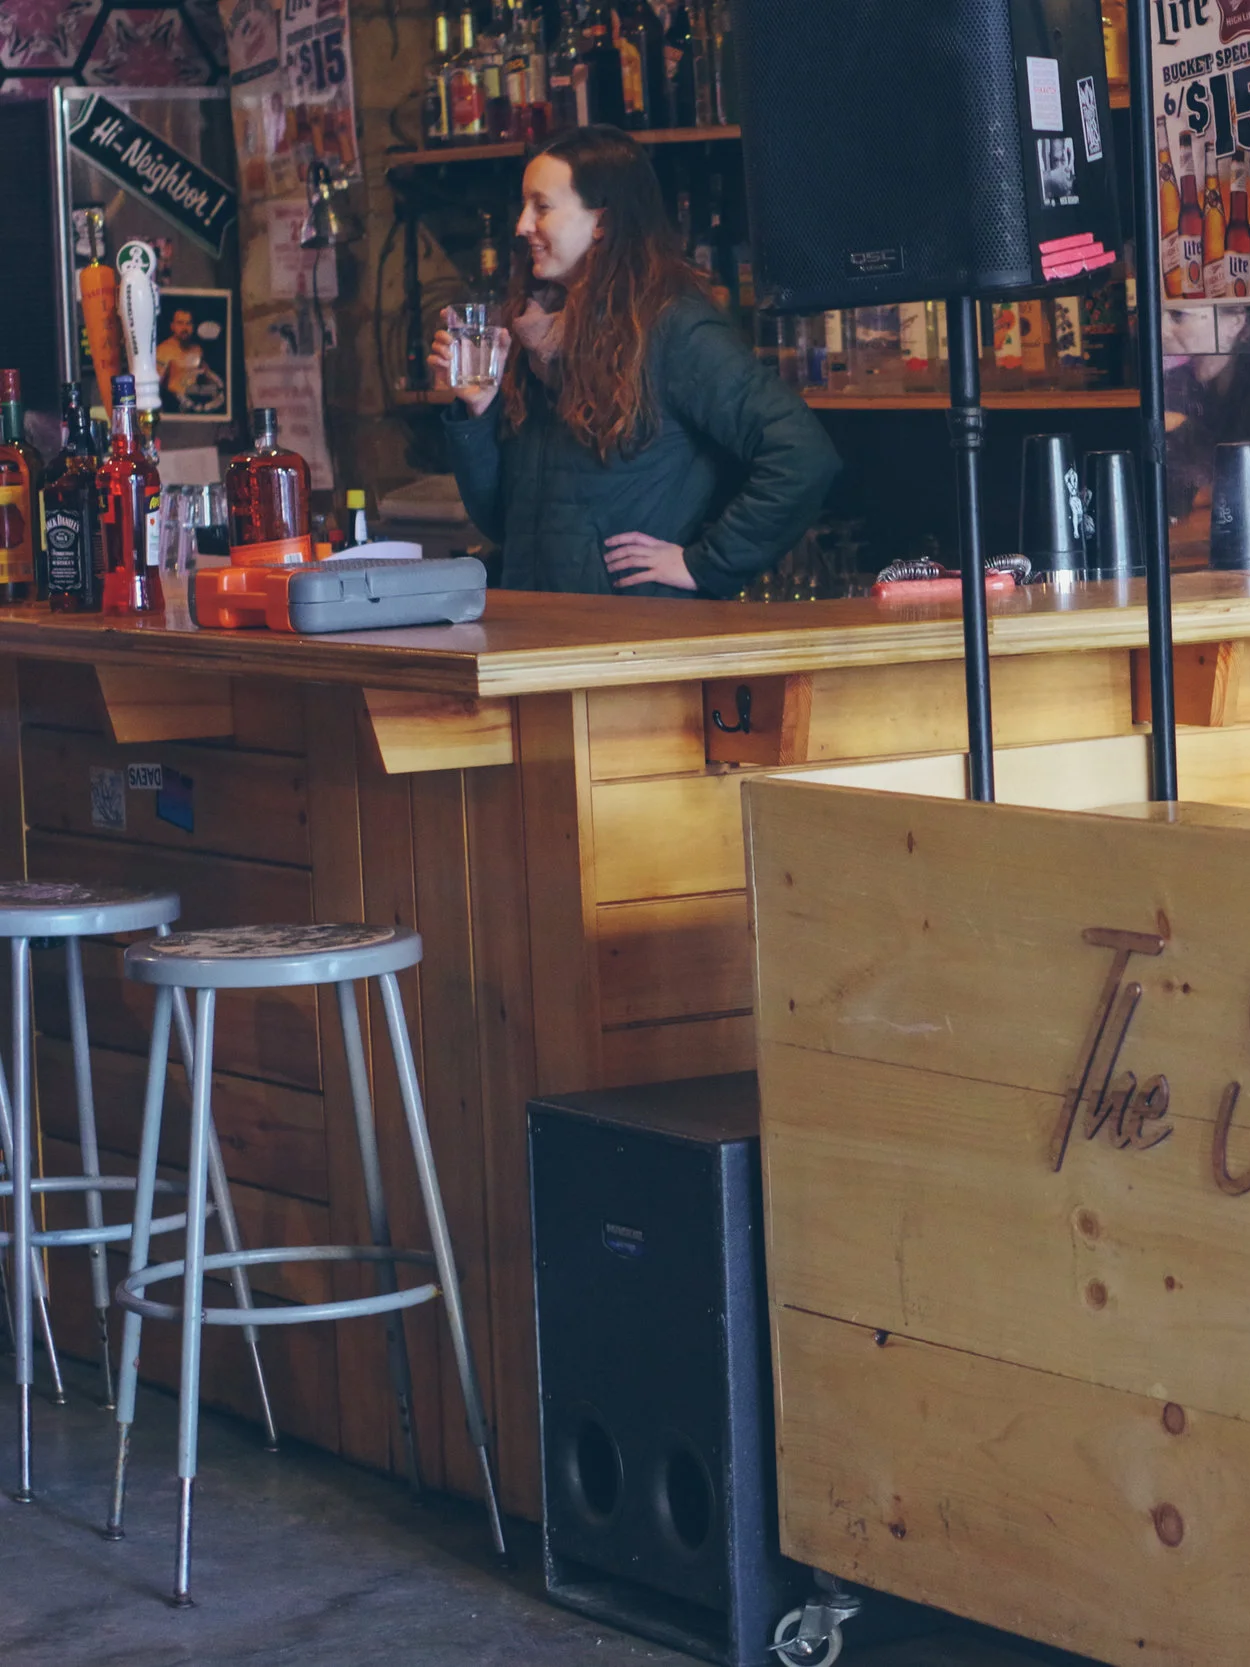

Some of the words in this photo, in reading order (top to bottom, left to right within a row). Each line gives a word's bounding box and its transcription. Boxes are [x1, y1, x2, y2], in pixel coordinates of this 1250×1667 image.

[1156, 0, 1210, 45] Lite
[1226, 15, 1242, 26] HIGH
[1163, 53, 1212, 84] BUCKET
[1047, 927, 1173, 1172] The
